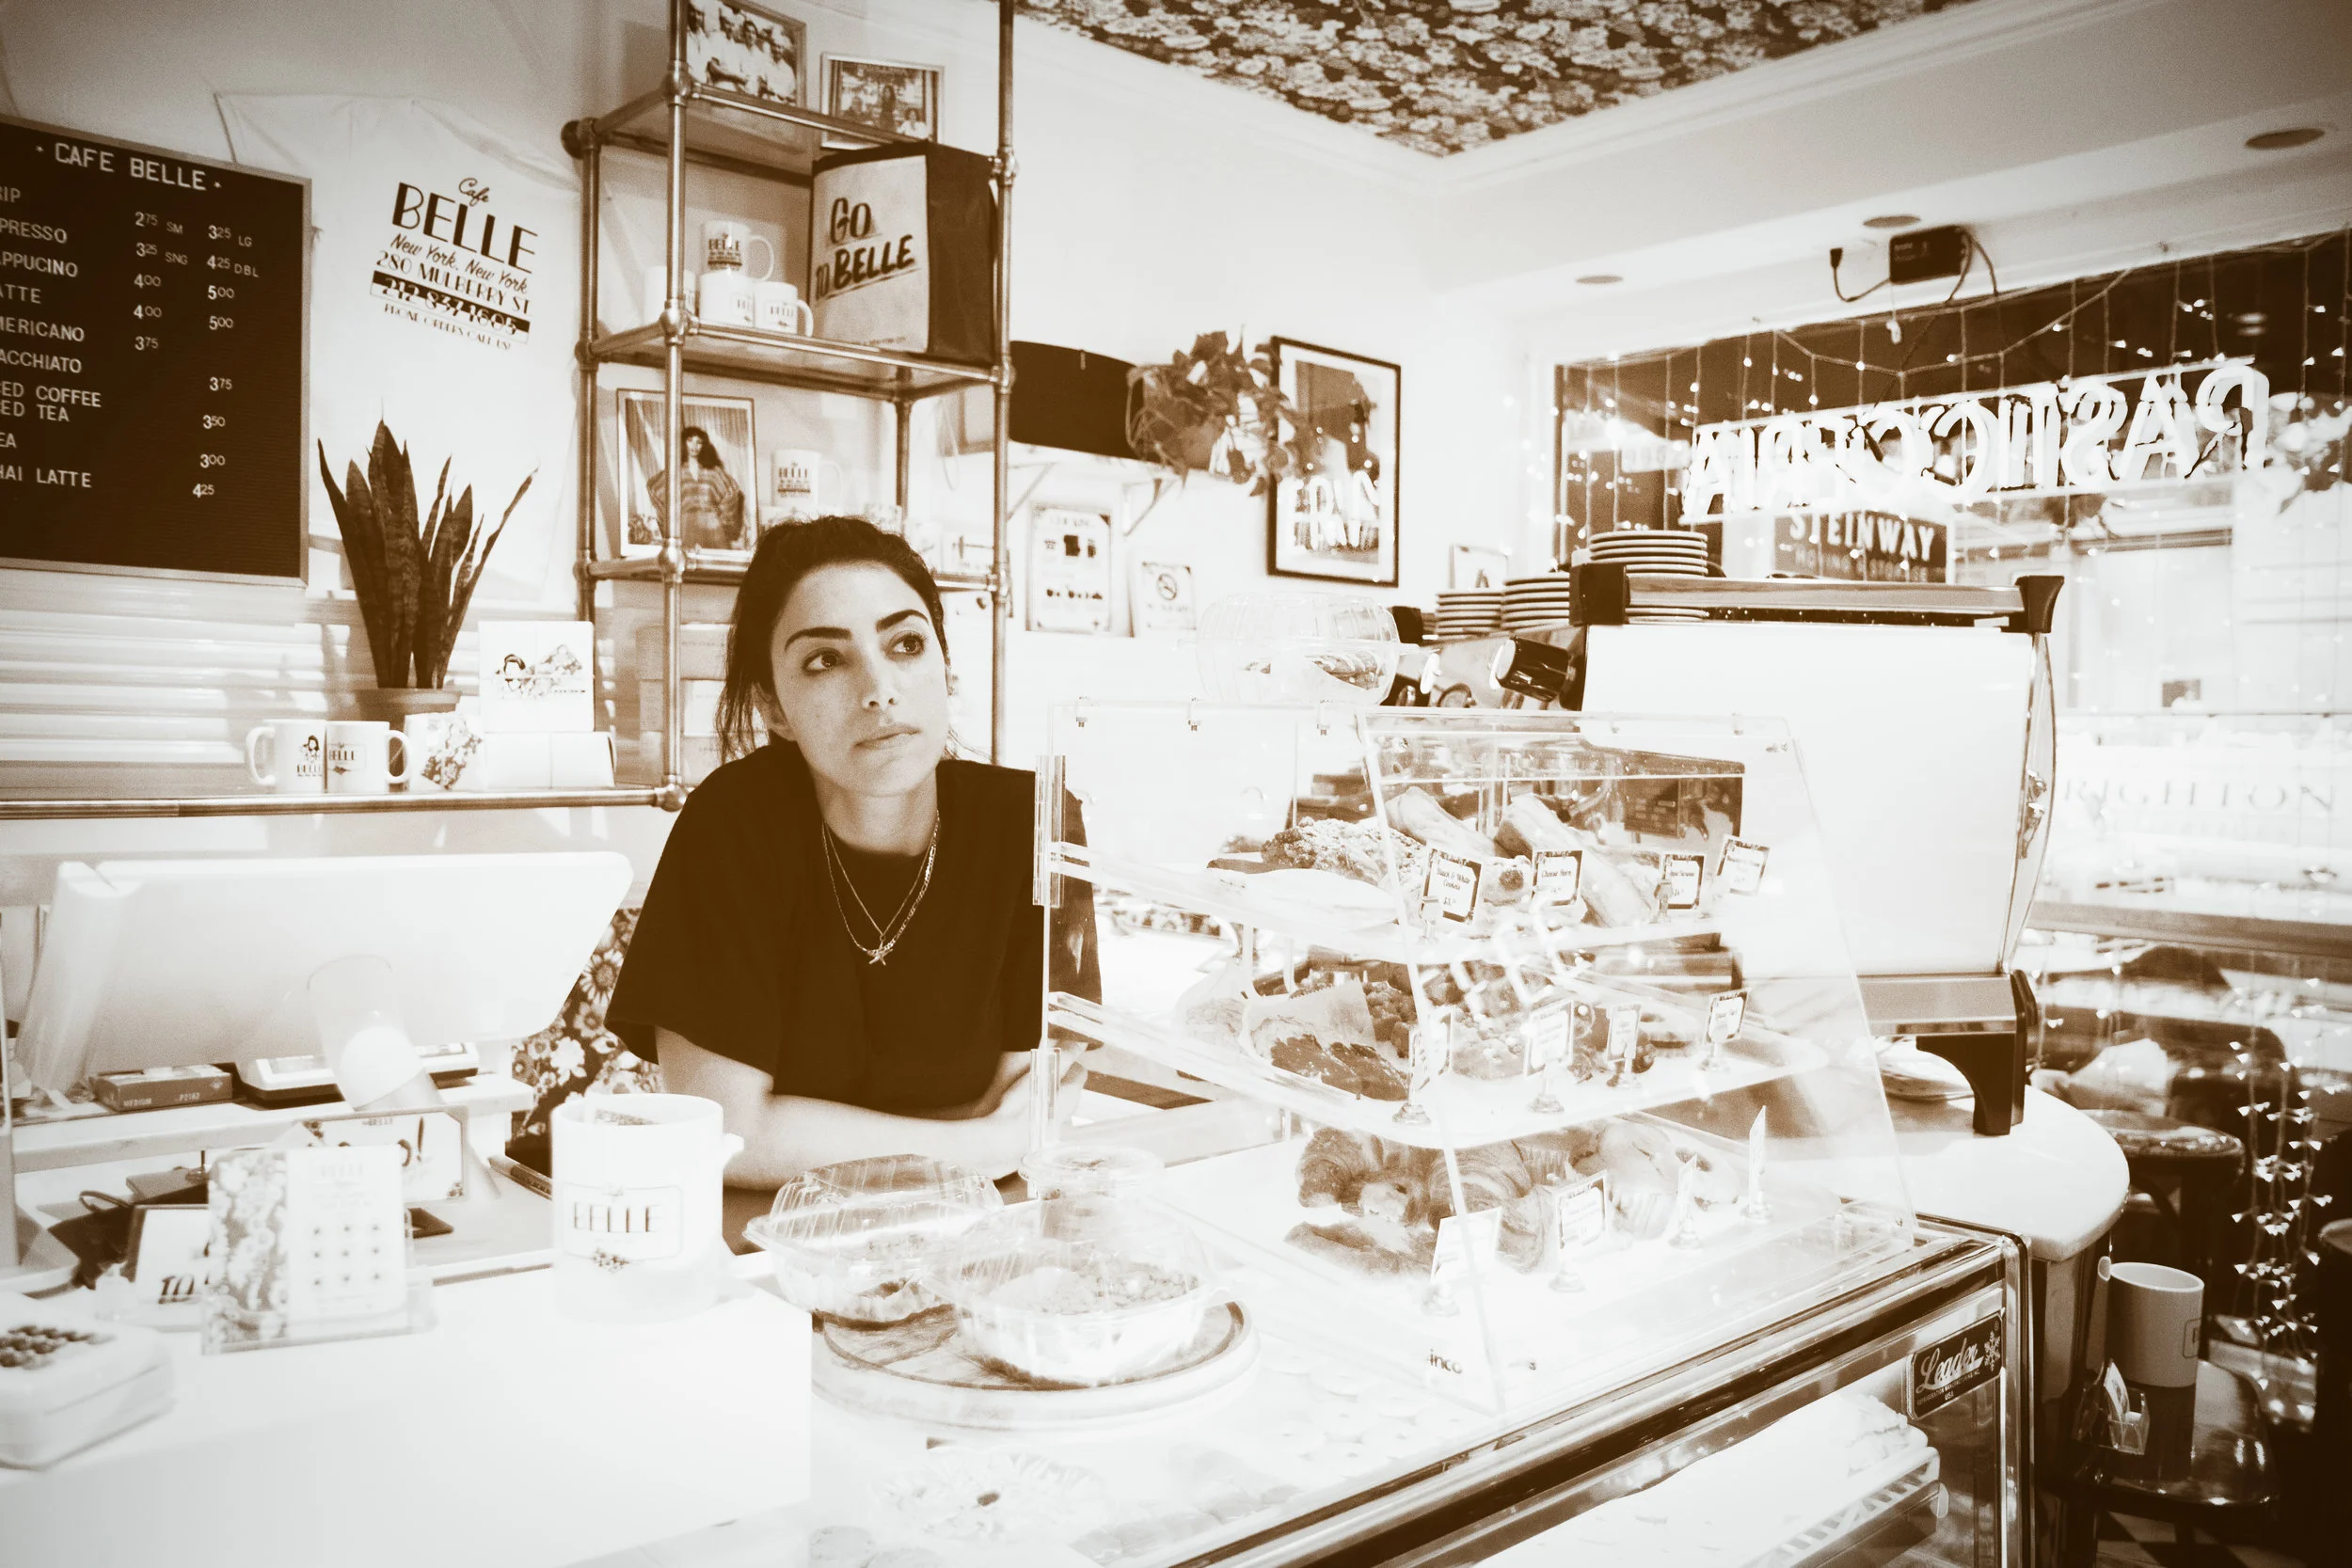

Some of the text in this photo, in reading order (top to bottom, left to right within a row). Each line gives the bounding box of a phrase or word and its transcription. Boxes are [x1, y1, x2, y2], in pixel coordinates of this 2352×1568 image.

[55, 142, 207, 190] CAFE BELLE
[392, 182, 538, 274] BELLE
[830, 198, 872, 244] GO
[2, 250, 78, 277] PPUCINO
[376, 249, 412, 275] 280
[419, 262, 506, 306] MULBERRY
[390, 232, 422, 255] New
[465, 259, 495, 280] New
[834, 234, 914, 290] BELLE
[36, 386, 102, 407] COFFEE
[37, 404, 70, 422] TEA
[37, 468, 92, 488] LATTE
[1789, 511, 1935, 562] STEINWAY
